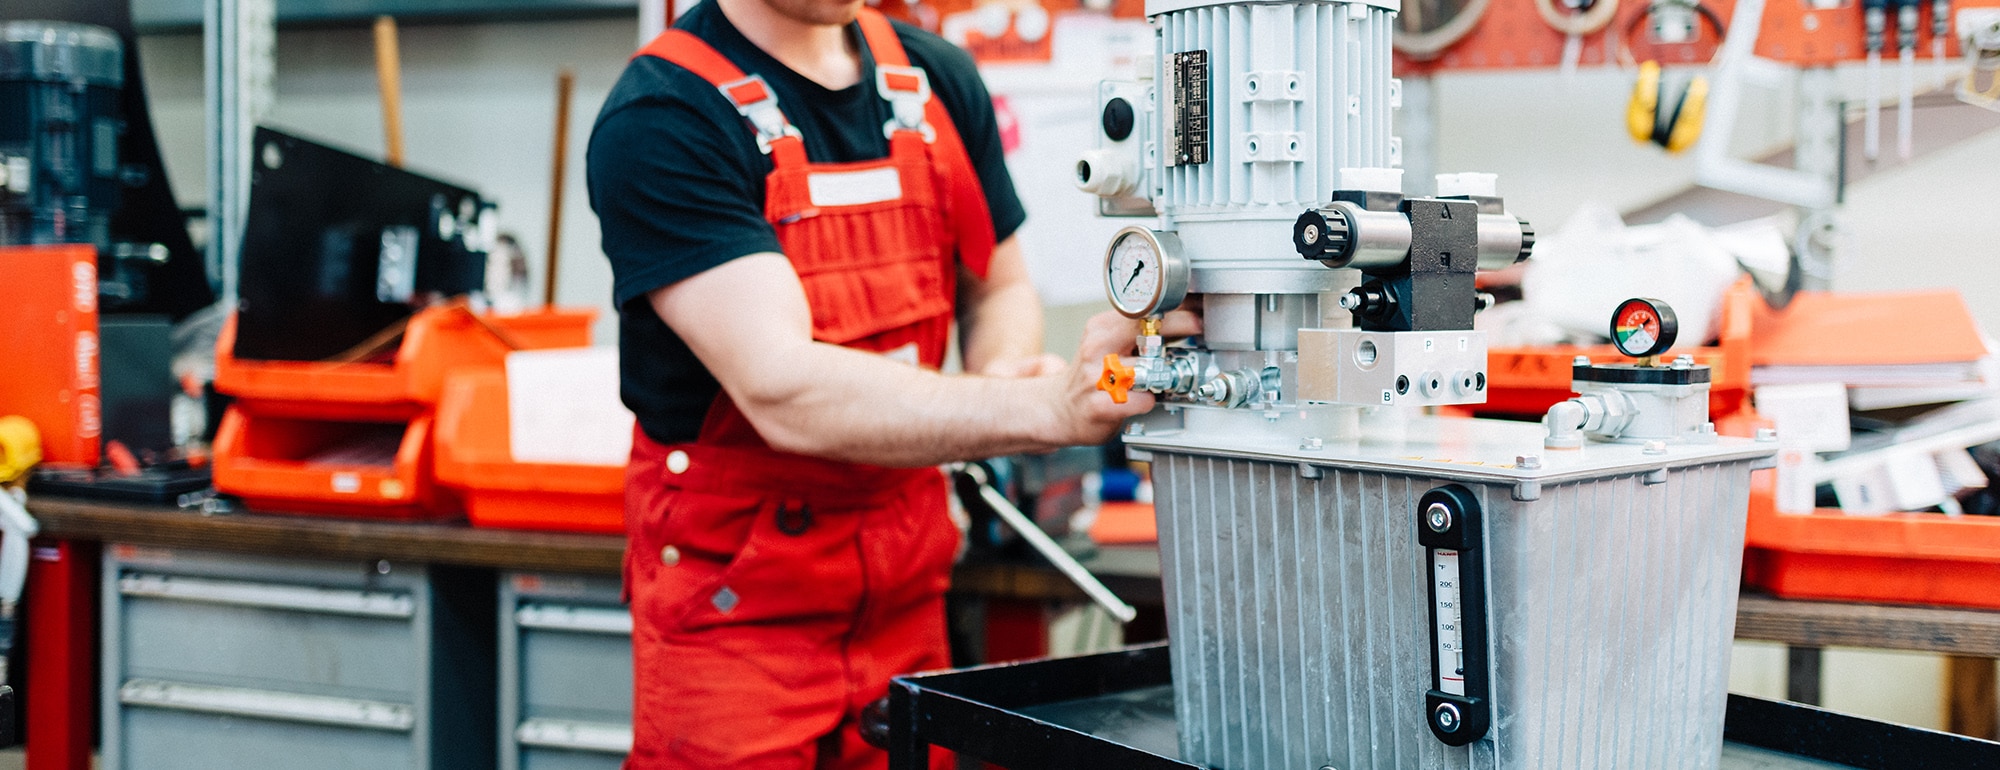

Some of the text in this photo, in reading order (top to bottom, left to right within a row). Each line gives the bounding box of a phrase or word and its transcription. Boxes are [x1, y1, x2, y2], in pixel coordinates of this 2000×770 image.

[1426, 339, 1465, 350] P T
[1384, 391, 1391, 402] B
[1441, 623, 1455, 631] 100
